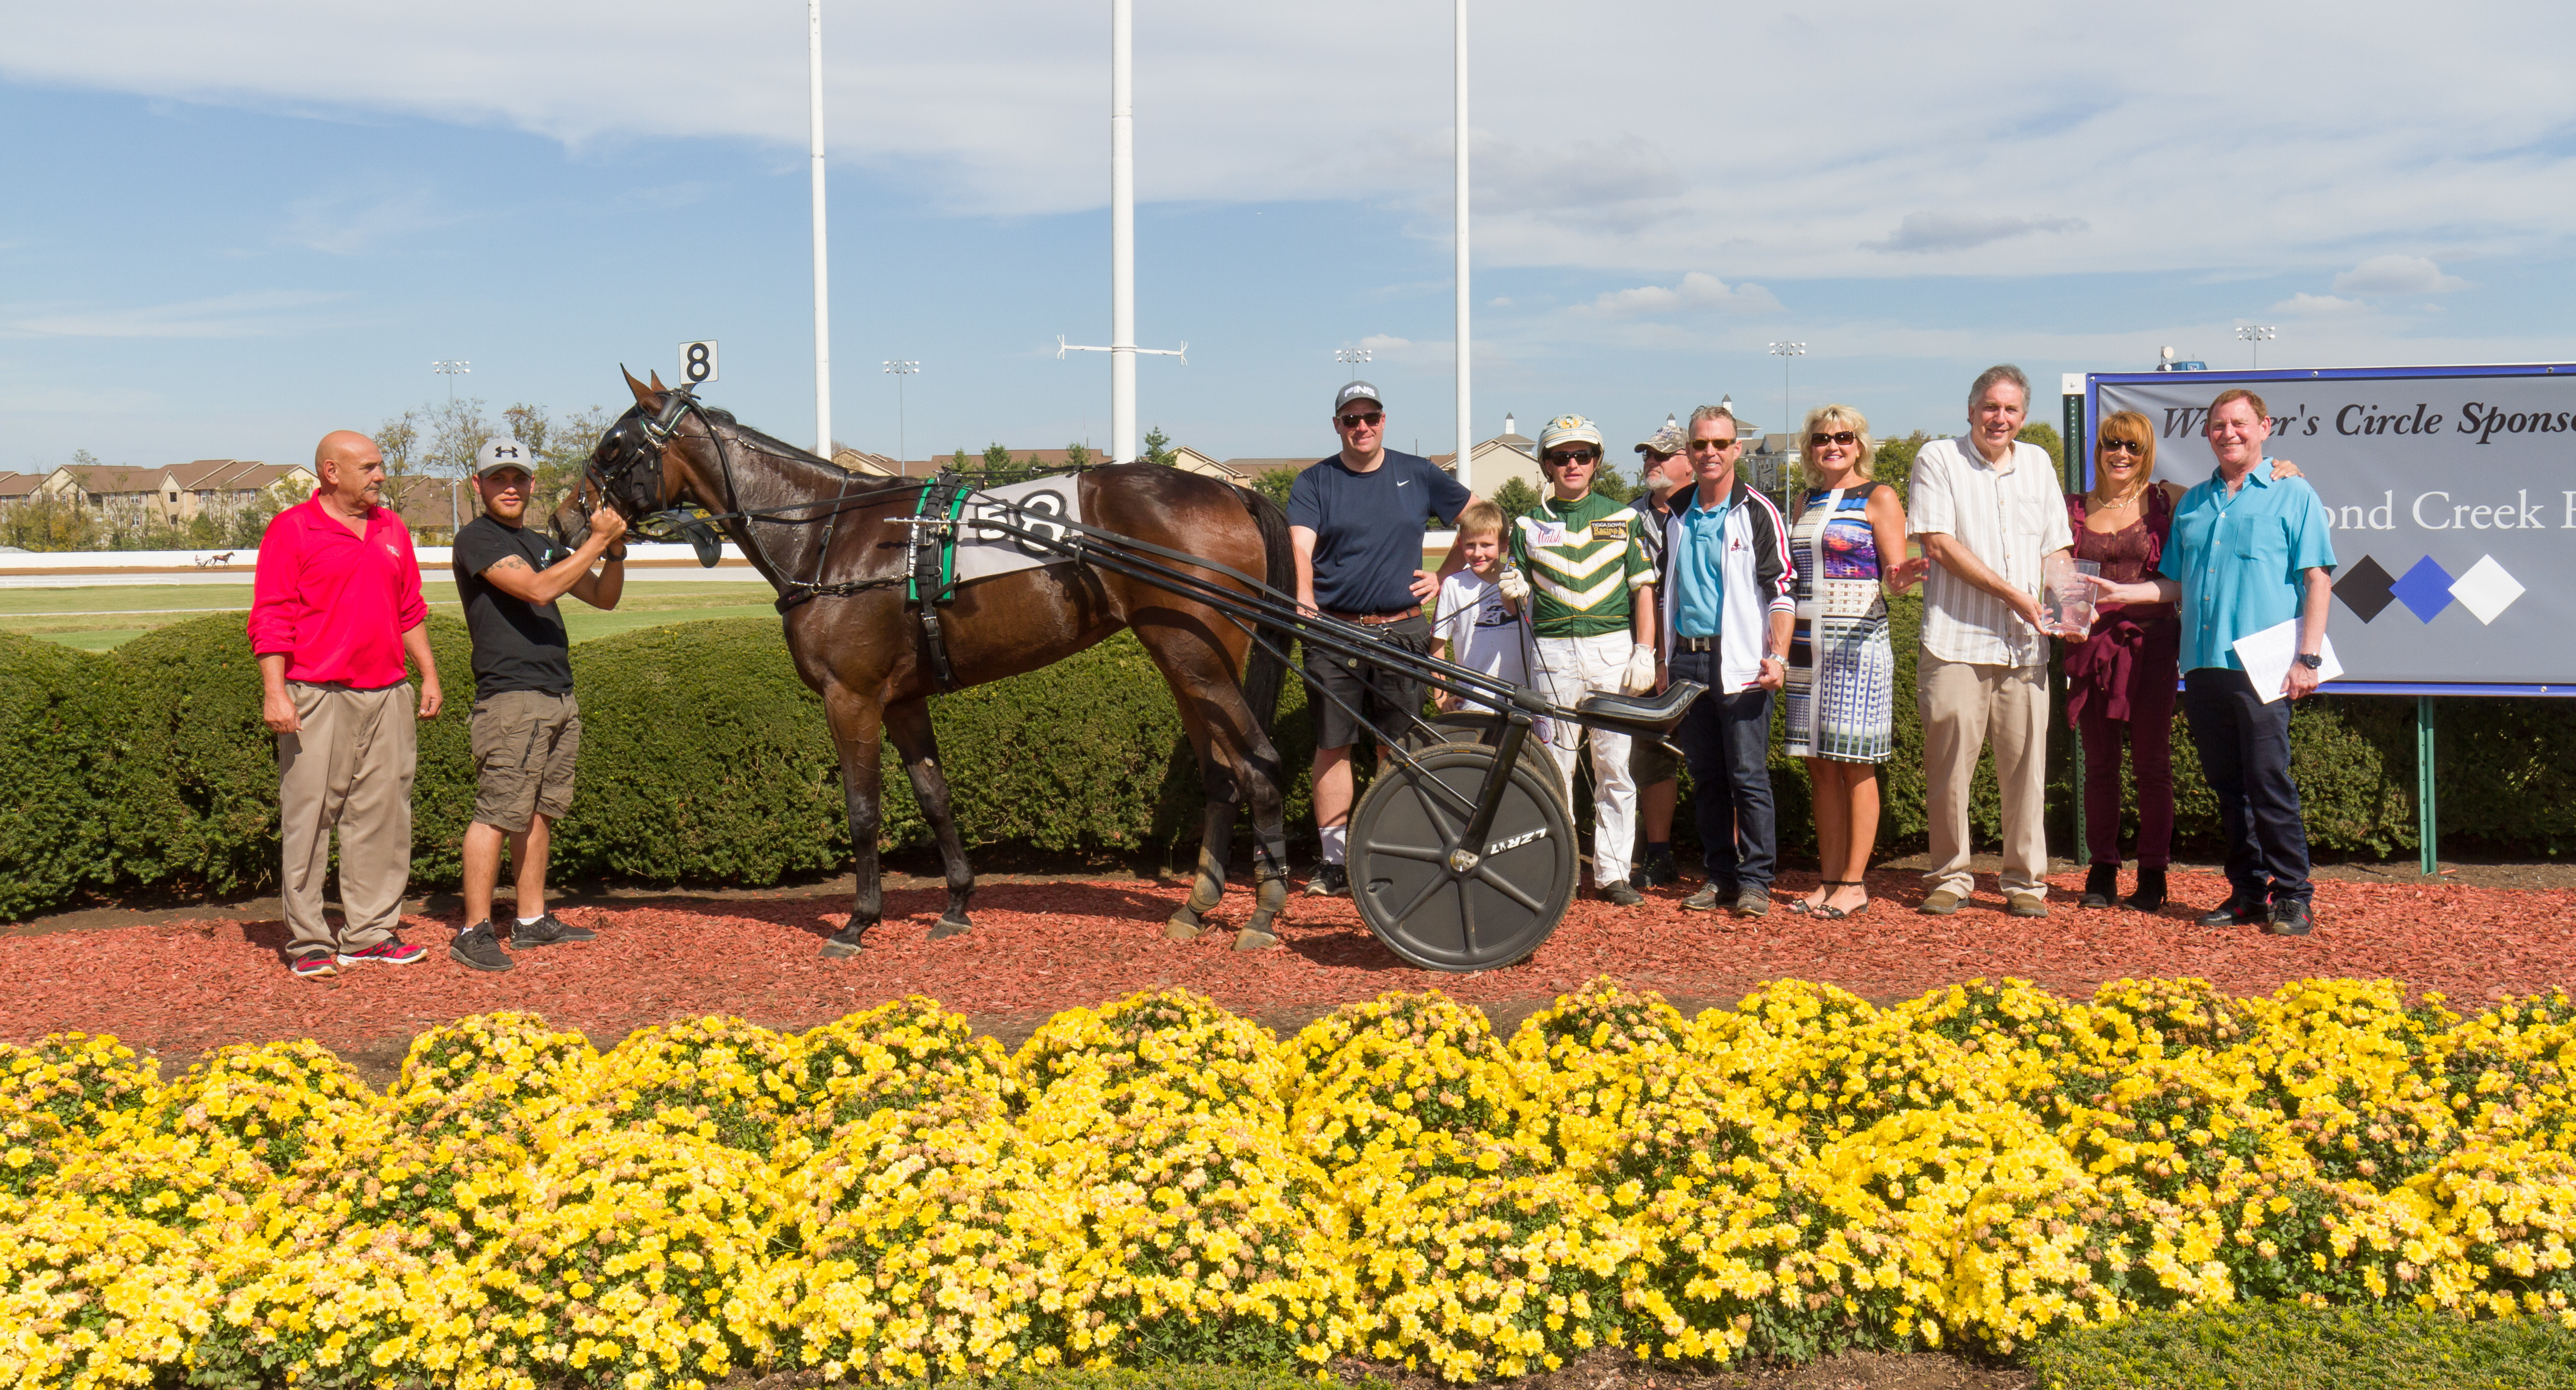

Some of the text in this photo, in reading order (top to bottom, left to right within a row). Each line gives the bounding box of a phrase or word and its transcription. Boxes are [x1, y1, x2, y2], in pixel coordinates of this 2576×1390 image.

[687, 342, 711, 382] 8
[1344, 385, 1375, 397] PING
[2164, 402, 2576, 444] Wier's Circle Spons
[2412, 489, 2546, 529] Creek
[1528, 525, 1562, 544] Walsh
